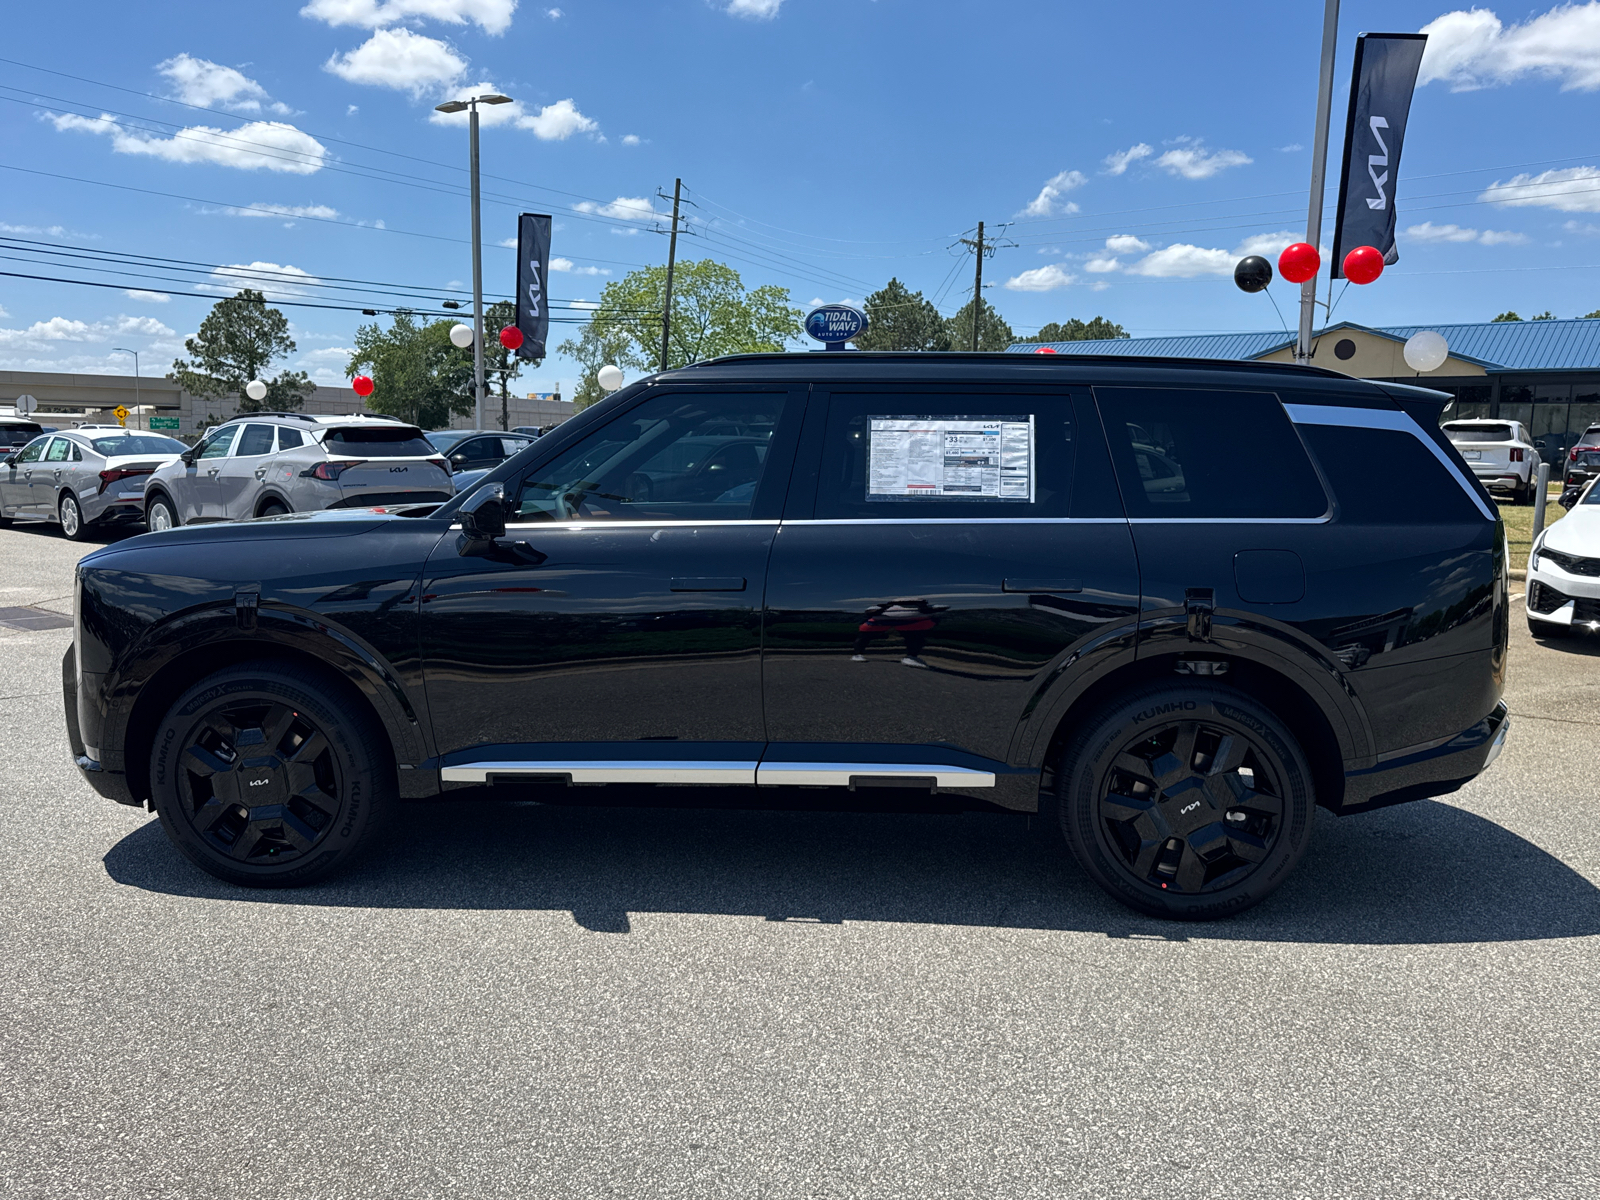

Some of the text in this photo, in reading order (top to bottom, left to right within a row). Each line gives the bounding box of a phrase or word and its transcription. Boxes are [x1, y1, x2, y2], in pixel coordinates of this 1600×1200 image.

[1365, 115, 1389, 210] KIA
[824, 312, 852, 321] TIDAL
[828, 321, 858, 331] WAVE
[1131, 700, 1197, 725] KUMHO
[156, 728, 176, 786] KUMHO
[250, 778, 269, 787] KIA
[339, 781, 361, 838] KUMHO
[1180, 800, 1201, 815] KIA
[1187, 891, 1251, 915] KUMHO
